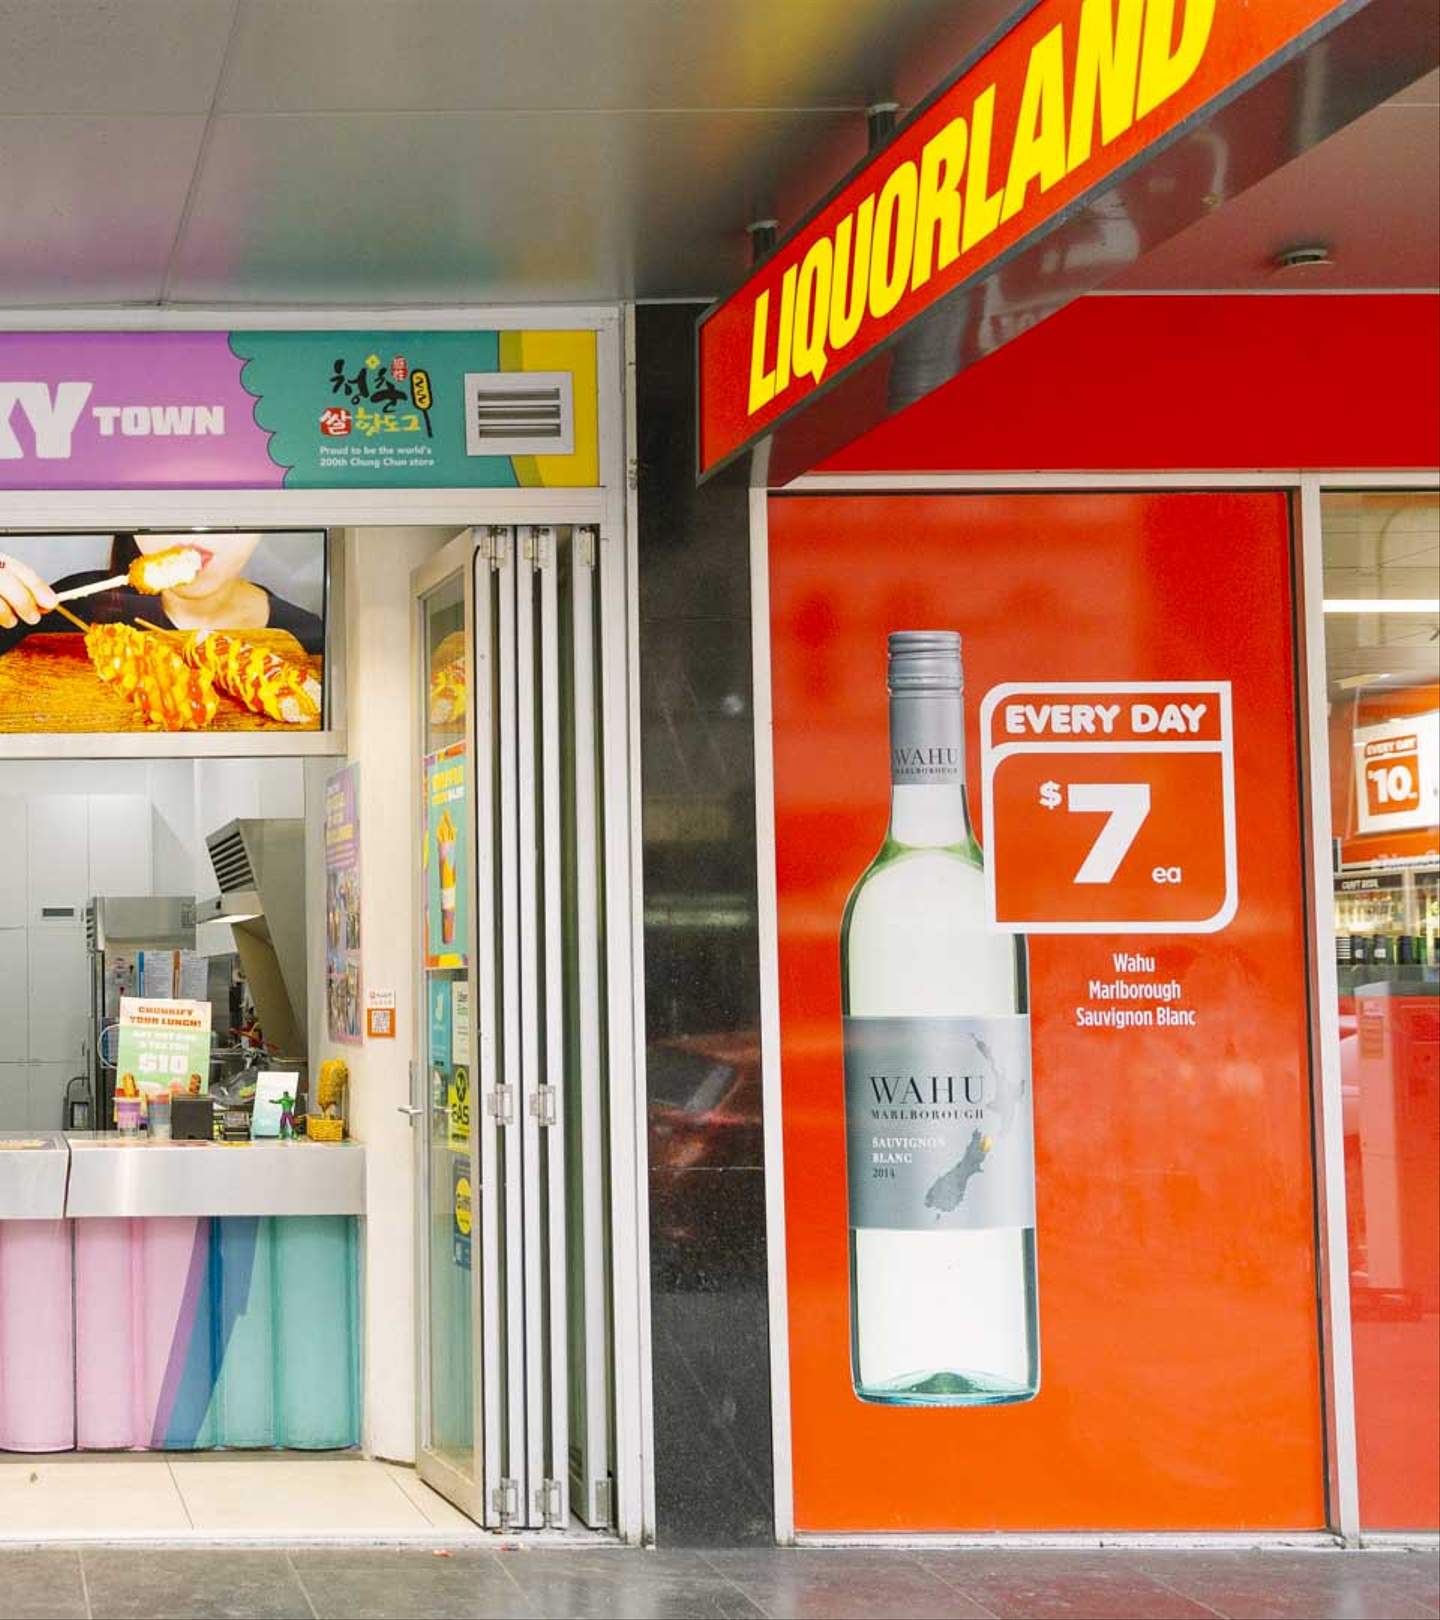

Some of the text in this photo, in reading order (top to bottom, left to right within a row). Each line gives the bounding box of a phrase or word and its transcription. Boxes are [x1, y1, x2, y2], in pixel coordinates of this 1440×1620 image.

[747, 0, 1216, 416] LIQUORLAND
[92, 405, 225, 436] TOWN
[320, 445, 432, 455] Proud to be the world's
[320, 458, 435, 469] 200th Chung Chun store
[1005, 703, 1207, 733] EVERY DAY
[895, 748, 959, 765] WAHU
[1152, 866, 1182, 884] ea
[1113, 953, 1156, 972] Wahu
[1088, 980, 1181, 1002] Marlborough
[129, 1015, 160, 1025] YOUR
[137, 1006, 194, 1017] CHUNKIFY
[1076, 1007, 1196, 1029] Sauvignon Blanc
[139, 1054, 189, 1075] $10
[869, 1076, 985, 1104] WAHU
[871, 1109, 984, 1120] MARLBOROUGH
[872, 1137, 946, 1149] SAUVIGNON
[872, 1153, 913, 1164] BLANC
